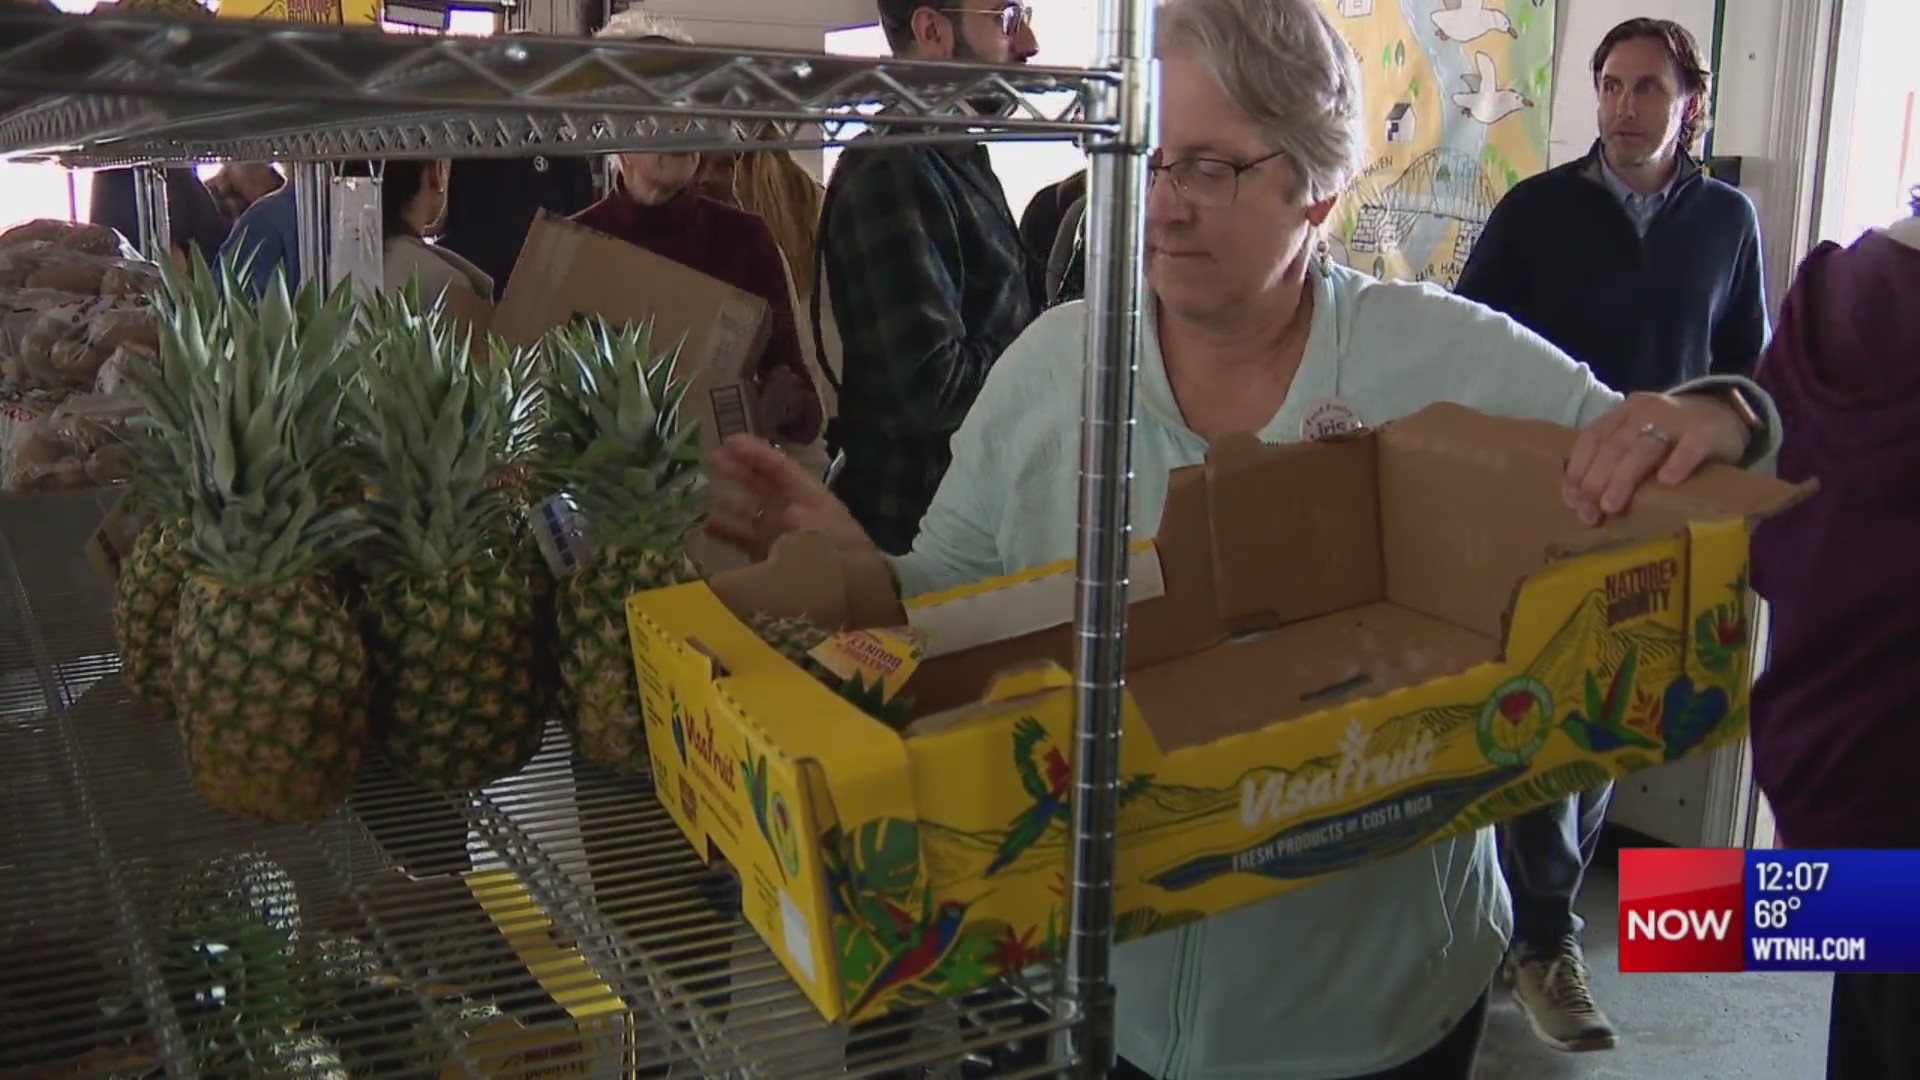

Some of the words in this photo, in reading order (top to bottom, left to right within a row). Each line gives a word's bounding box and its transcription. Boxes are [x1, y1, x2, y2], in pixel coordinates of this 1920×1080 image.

[1362, 155, 1393, 177] HAVEN
[1231, 843, 1276, 872] FRESH
[1276, 820, 1345, 858] PRODUCTS
[1361, 803, 1402, 831] COSTA
[1404, 794, 1434, 818] RICA
